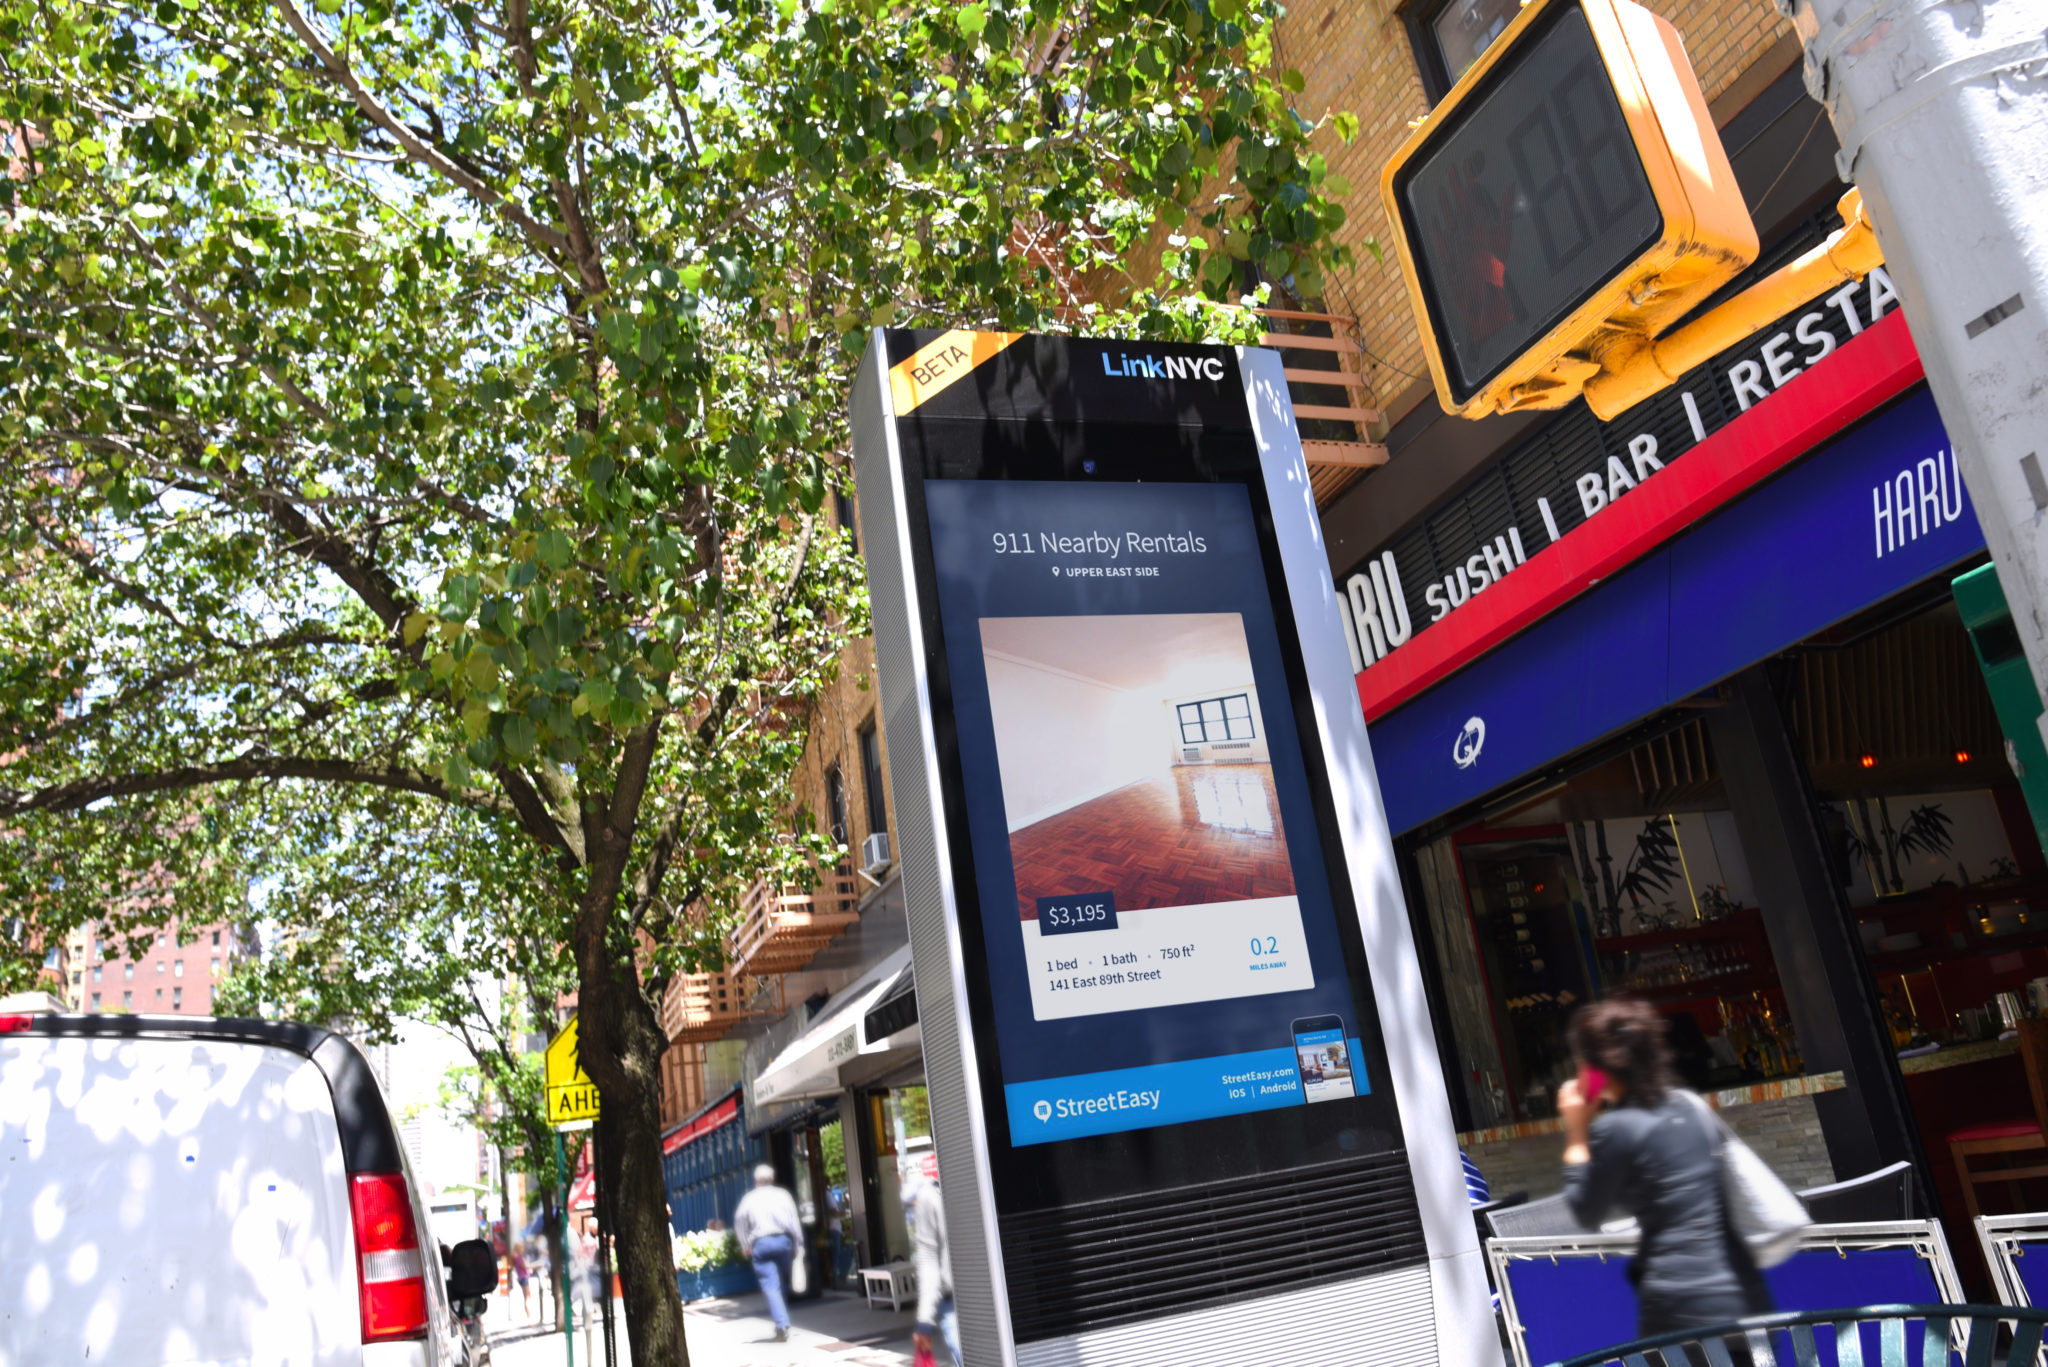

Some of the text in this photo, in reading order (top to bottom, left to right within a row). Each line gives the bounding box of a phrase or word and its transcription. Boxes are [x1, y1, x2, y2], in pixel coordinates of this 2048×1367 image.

[910, 345, 969, 386] BETA
[1101, 351, 1225, 382] LinkNYC
[1425, 526, 1527, 622] SUSHI
[1576, 433, 1666, 518] BAR
[1728, 266, 1900, 412] RESTA
[1872, 445, 1963, 559] HARU
[992, 530, 1208, 559] 911 Nearby Rentals
[1066, 567, 1160, 577] UPPER EAST SIDE
[1048, 904, 1107, 927] $3,195
[1250, 936, 1280, 956] 0.2
[1047, 961, 1054, 972] 1
[1056, 958, 1079, 971] bed
[1102, 955, 1109, 966] 1
[1111, 952, 1138, 965] bath
[1160, 948, 1181, 960] 750
[1269, 961, 1287, 969] AWAY
[1050, 969, 1162, 991] 141 East 89th Street
[1222, 1068, 1294, 1085] StreetEasy.com
[1260, 1081, 1297, 1095] Android
[1056, 1090, 1160, 1118] StreetEasy
